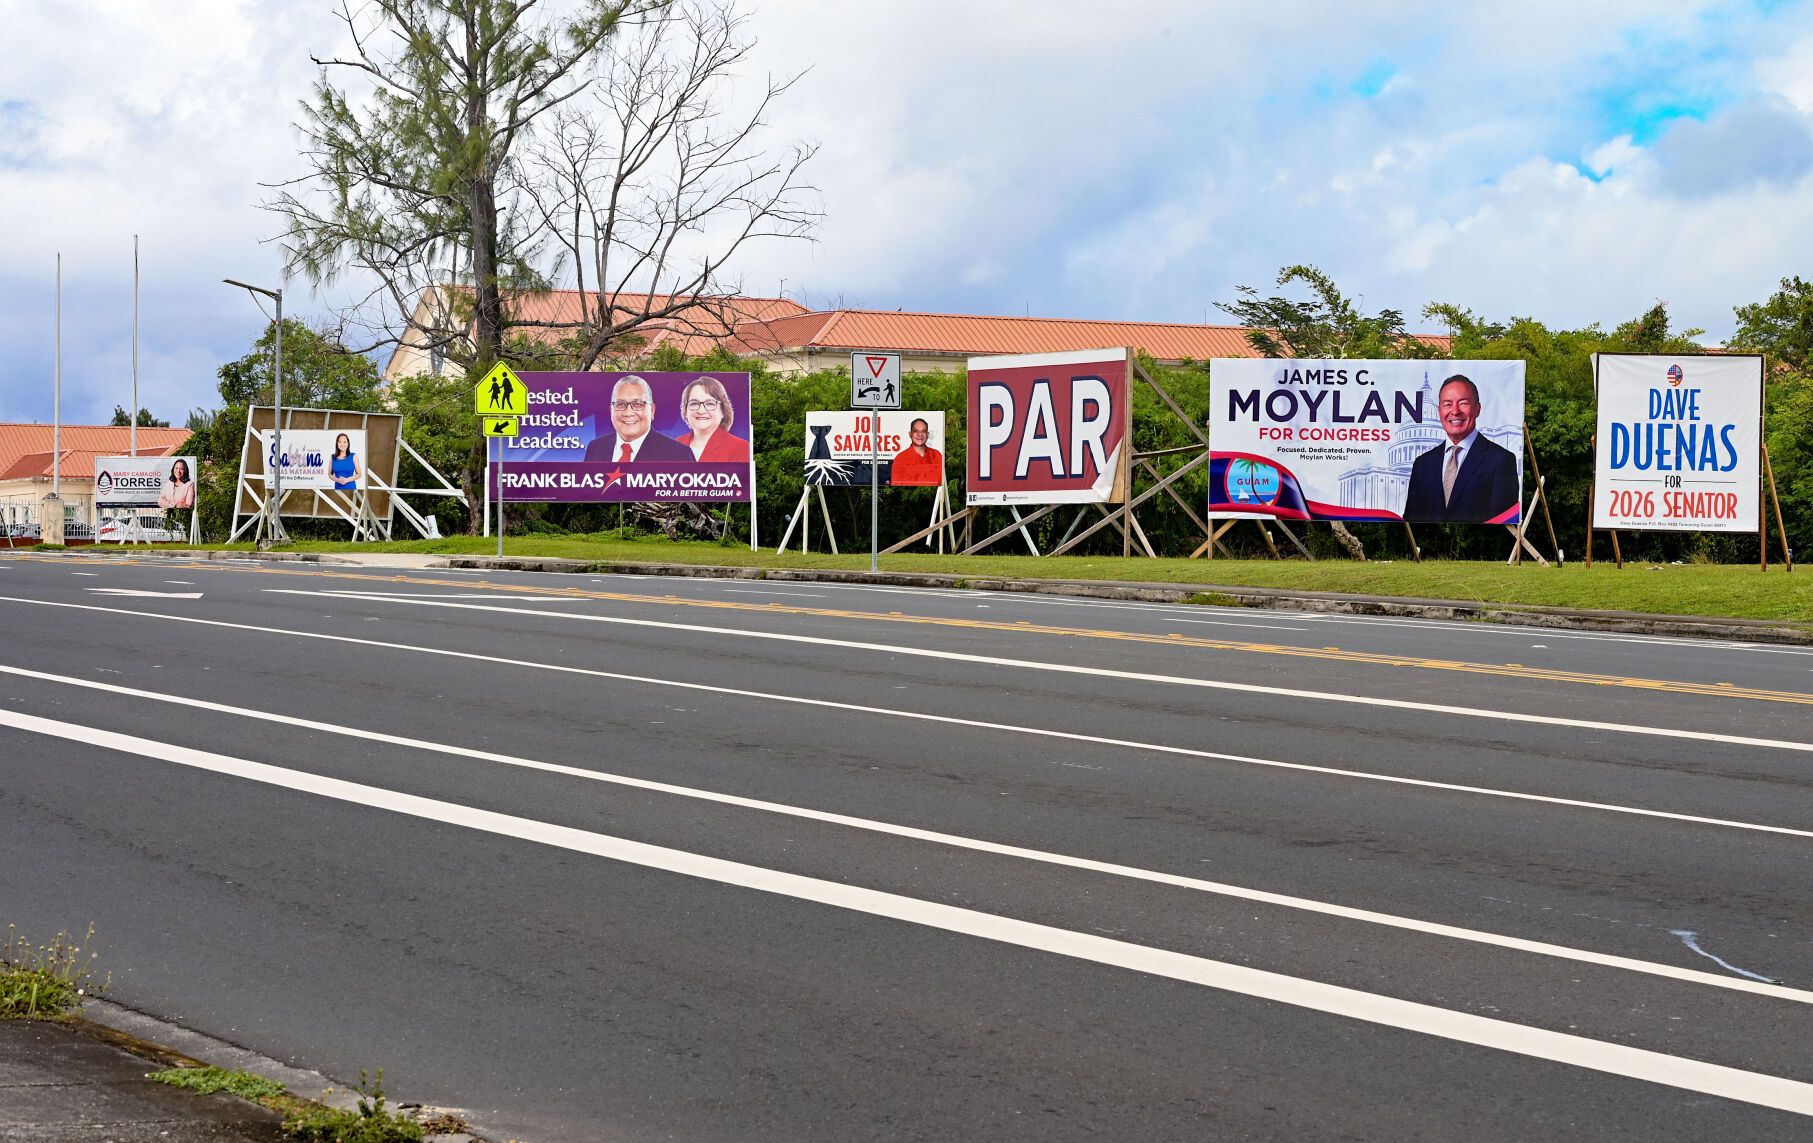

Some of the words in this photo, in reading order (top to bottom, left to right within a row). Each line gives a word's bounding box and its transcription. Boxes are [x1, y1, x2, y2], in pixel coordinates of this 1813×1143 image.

[857, 377, 873, 385] HERE
[1278, 369, 1348, 385] JAMES
[1355, 369, 1375, 386] C.
[528, 387, 579, 404] ested.
[1648, 388, 1701, 420] DAVE
[1228, 389, 1423, 424] MOYLAN
[513, 409, 584, 426] rusted.
[978, 375, 1112, 481] PAR
[1259, 427, 1293, 440] FOR
[1299, 428, 1391, 442] CONGRESS
[508, 431, 585, 449] Leaders.
[834, 435, 901, 452] SAVARES
[1610, 422, 1738, 472] DUENAS
[269, 443, 323, 468] Sabrina
[1308, 446, 1345, 454] Dedicated.
[113, 477, 161, 487] TORRES
[497, 473, 558, 488] FRANK
[560, 473, 605, 488] BLAS
[626, 473, 678, 487] MARY
[679, 473, 742, 488] OKADA
[1665, 475, 1681, 488] FOR
[1609, 490, 1655, 518] 2026
[1663, 491, 1737, 519] SENATOR
